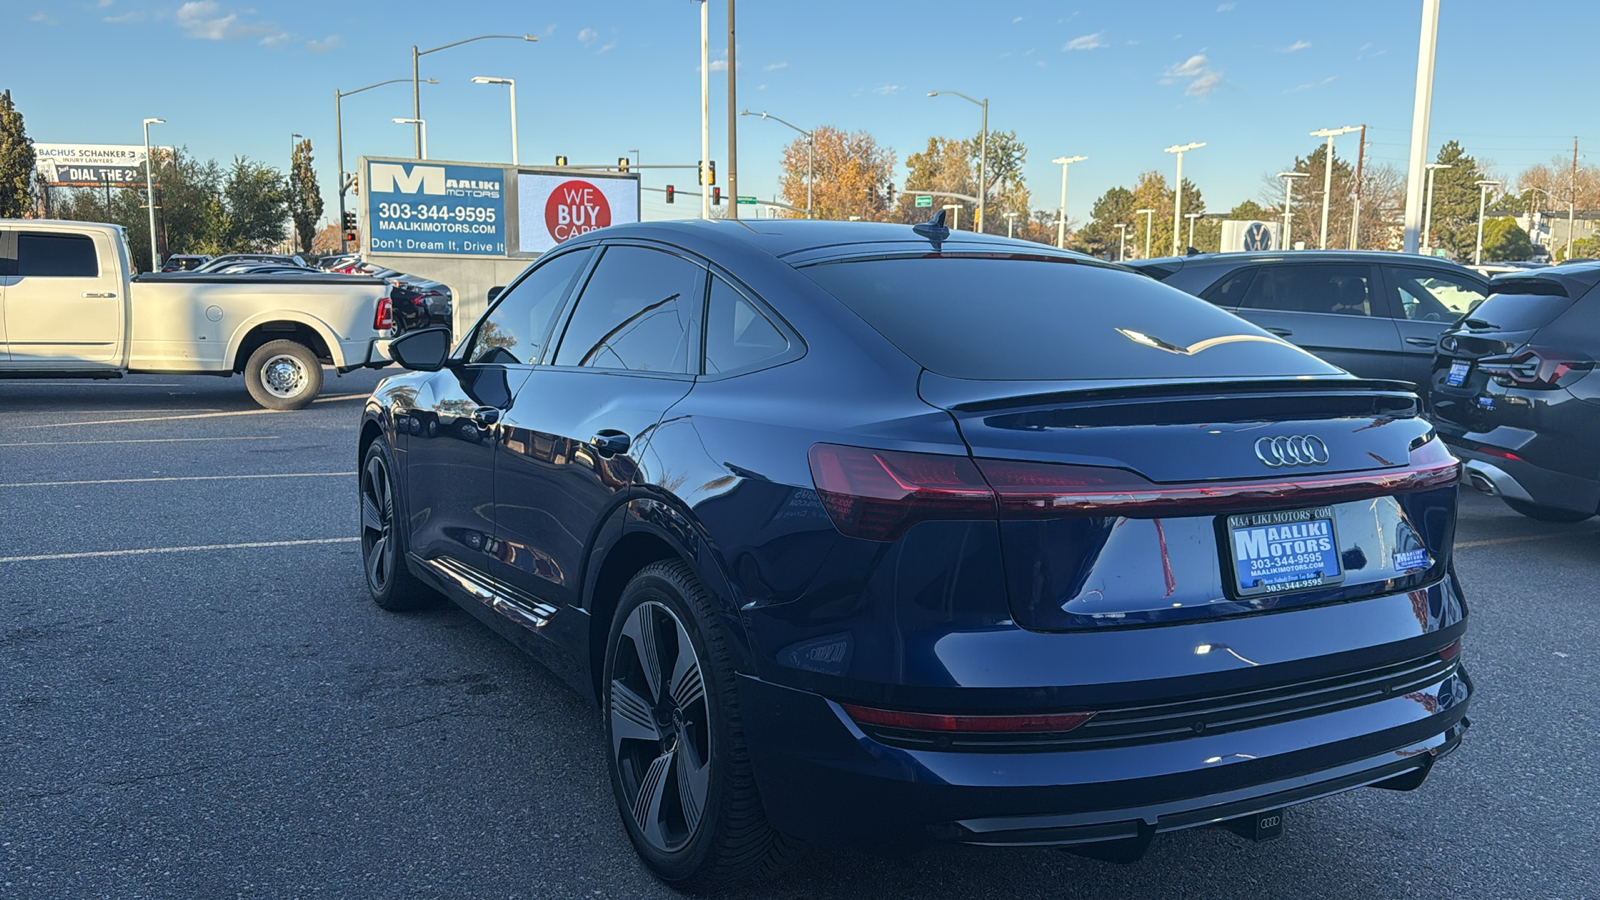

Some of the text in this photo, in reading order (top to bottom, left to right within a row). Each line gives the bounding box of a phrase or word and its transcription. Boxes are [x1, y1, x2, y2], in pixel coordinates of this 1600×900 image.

[39, 148, 126, 158] BACHUS SCHANKER
[70, 168, 97, 180] DIAL
[99, 169, 123, 181] THE
[446, 189, 500, 199] MOTORS
[563, 187, 594, 207] WE
[379, 202, 496, 223] 303-344-9595
[557, 204, 600, 226] BUY
[379, 220, 496, 234] MAALIKIMOTORS.COM
[371, 237, 504, 252] Don't Dream It, Drive It
[1250, 552, 1322, 570] 303-344-9595
[1250, 562, 1325, 577] MAALIKIMOTORS.COM
[1266, 577, 1323, 593] 303-344-9595
